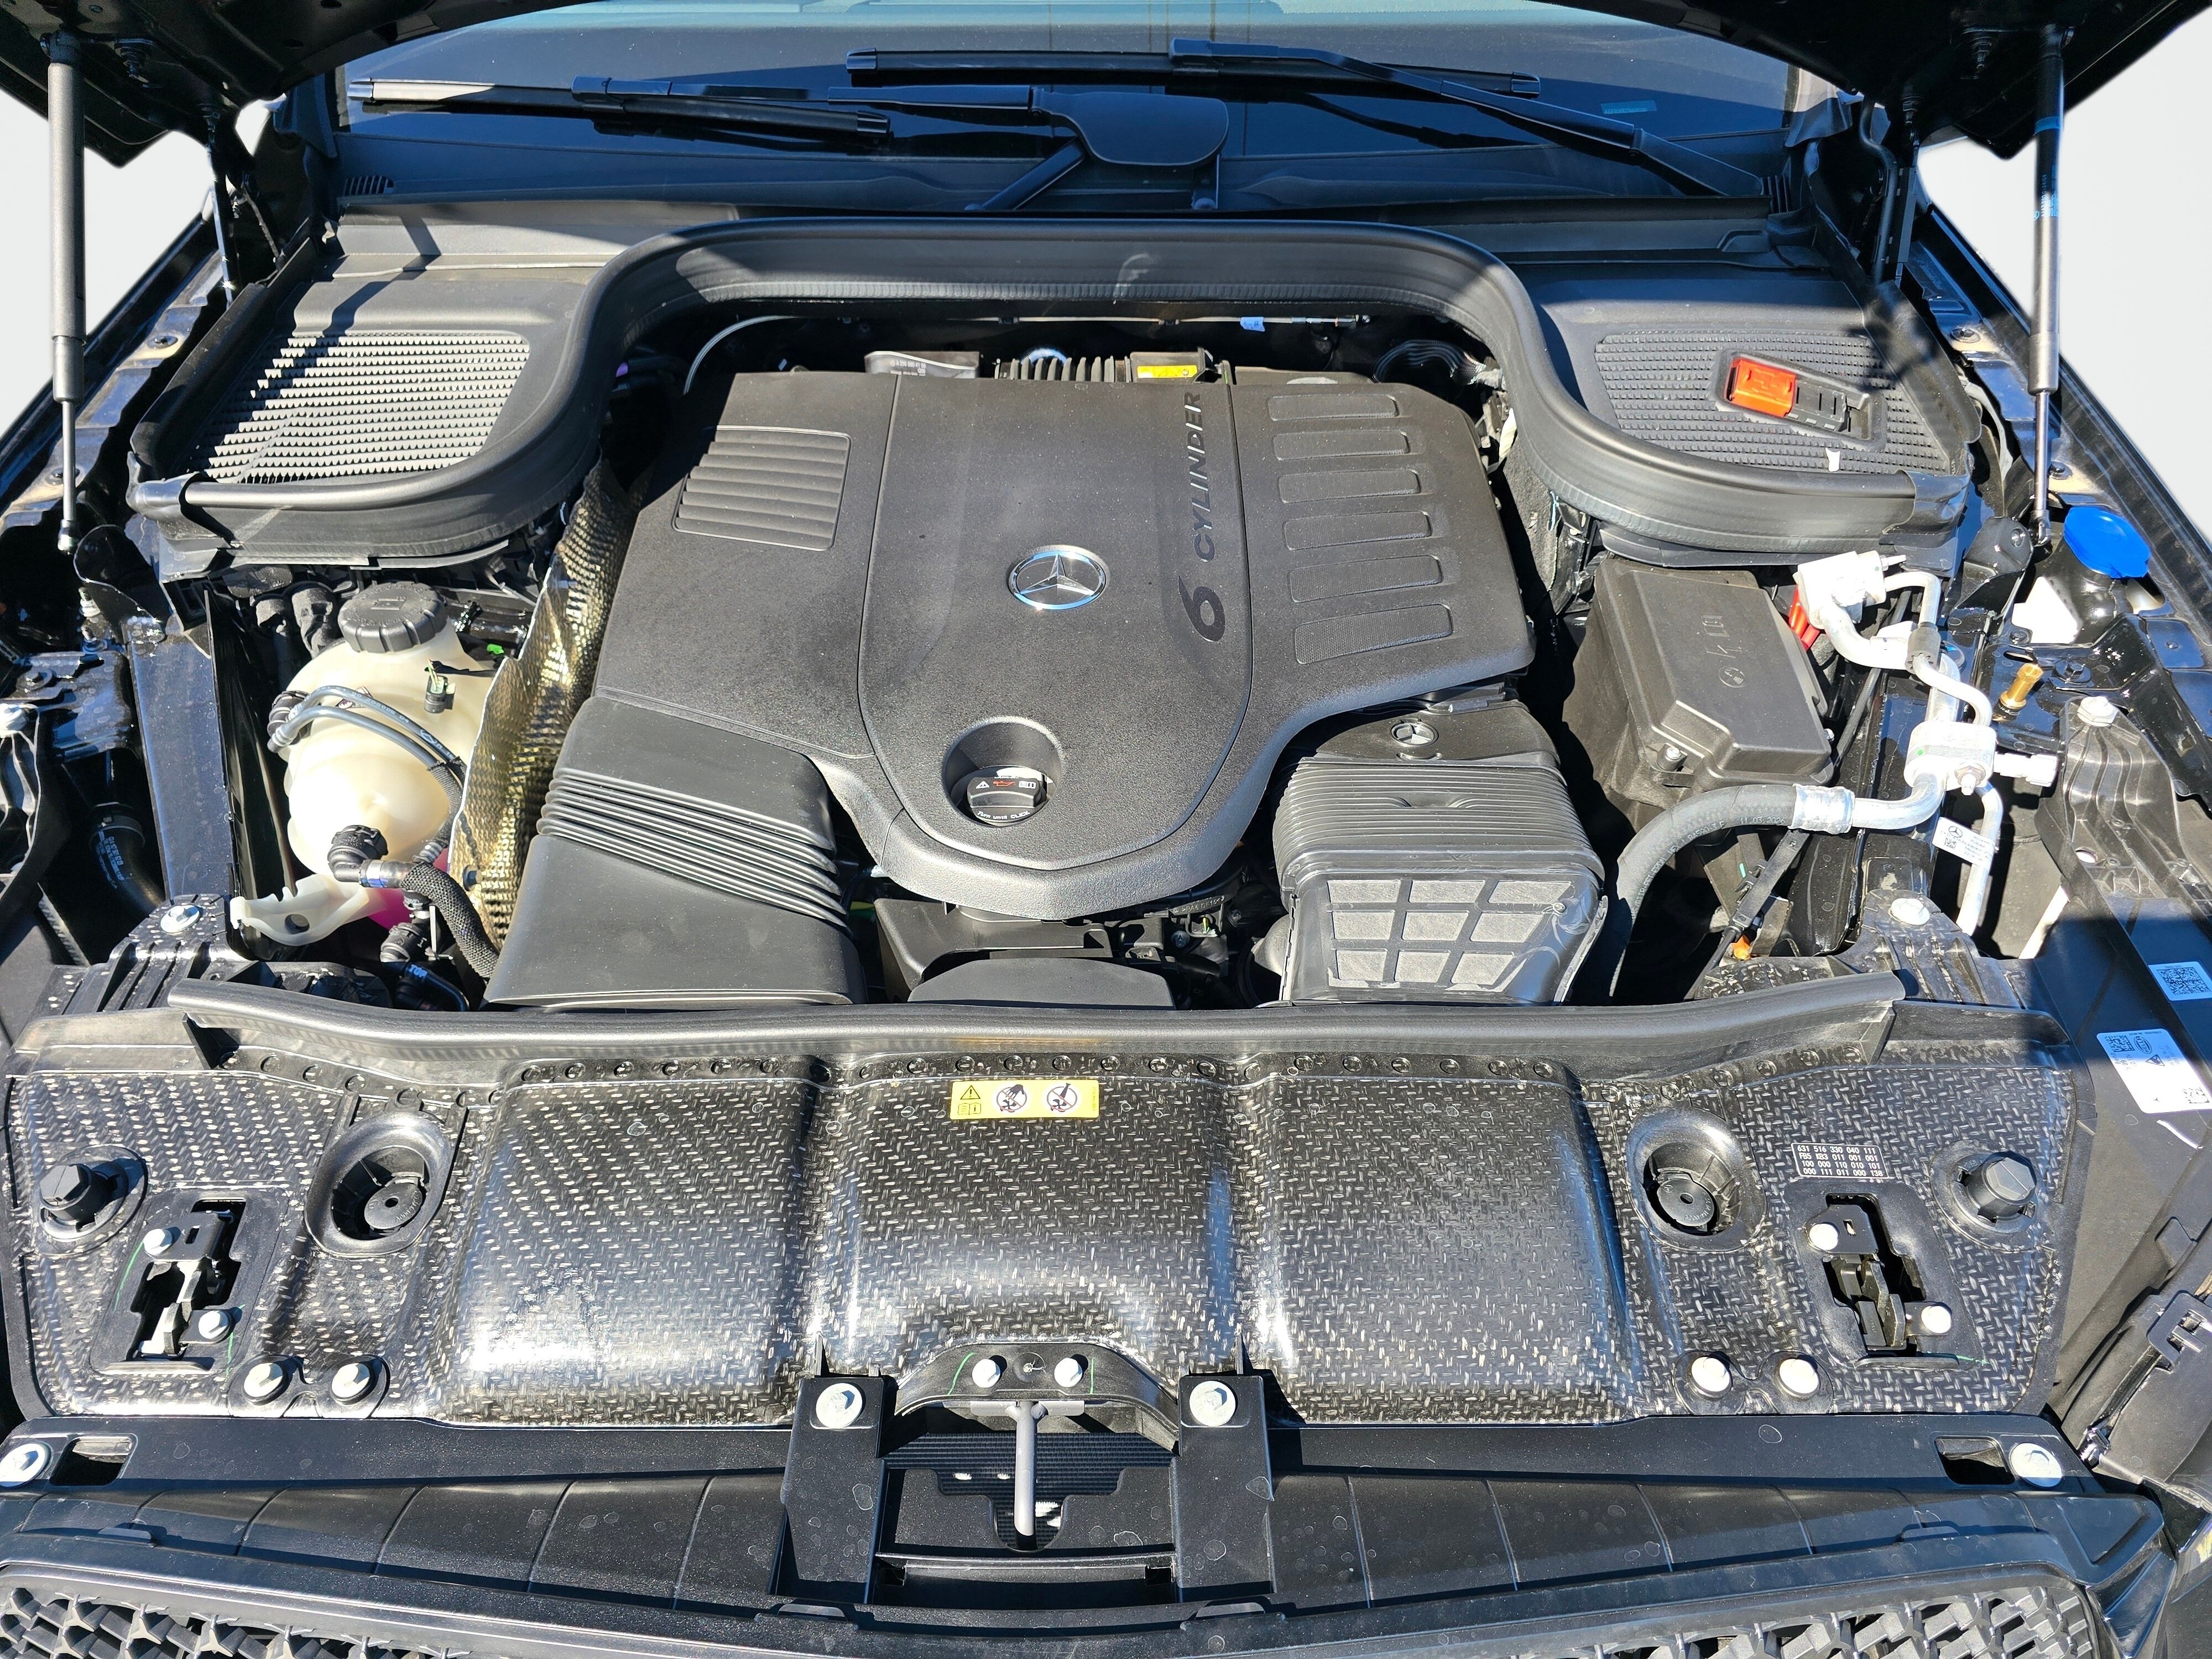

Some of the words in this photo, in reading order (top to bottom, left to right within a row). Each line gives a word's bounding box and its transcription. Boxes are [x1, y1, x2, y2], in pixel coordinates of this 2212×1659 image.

[1184, 392, 1215, 562] CYLINDER
[1178, 576, 1225, 643] 6
[977, 810, 991, 818] Turn
[1010, 810, 1031, 819] CLICK
[2135, 1036, 2149, 1053] HELLA
